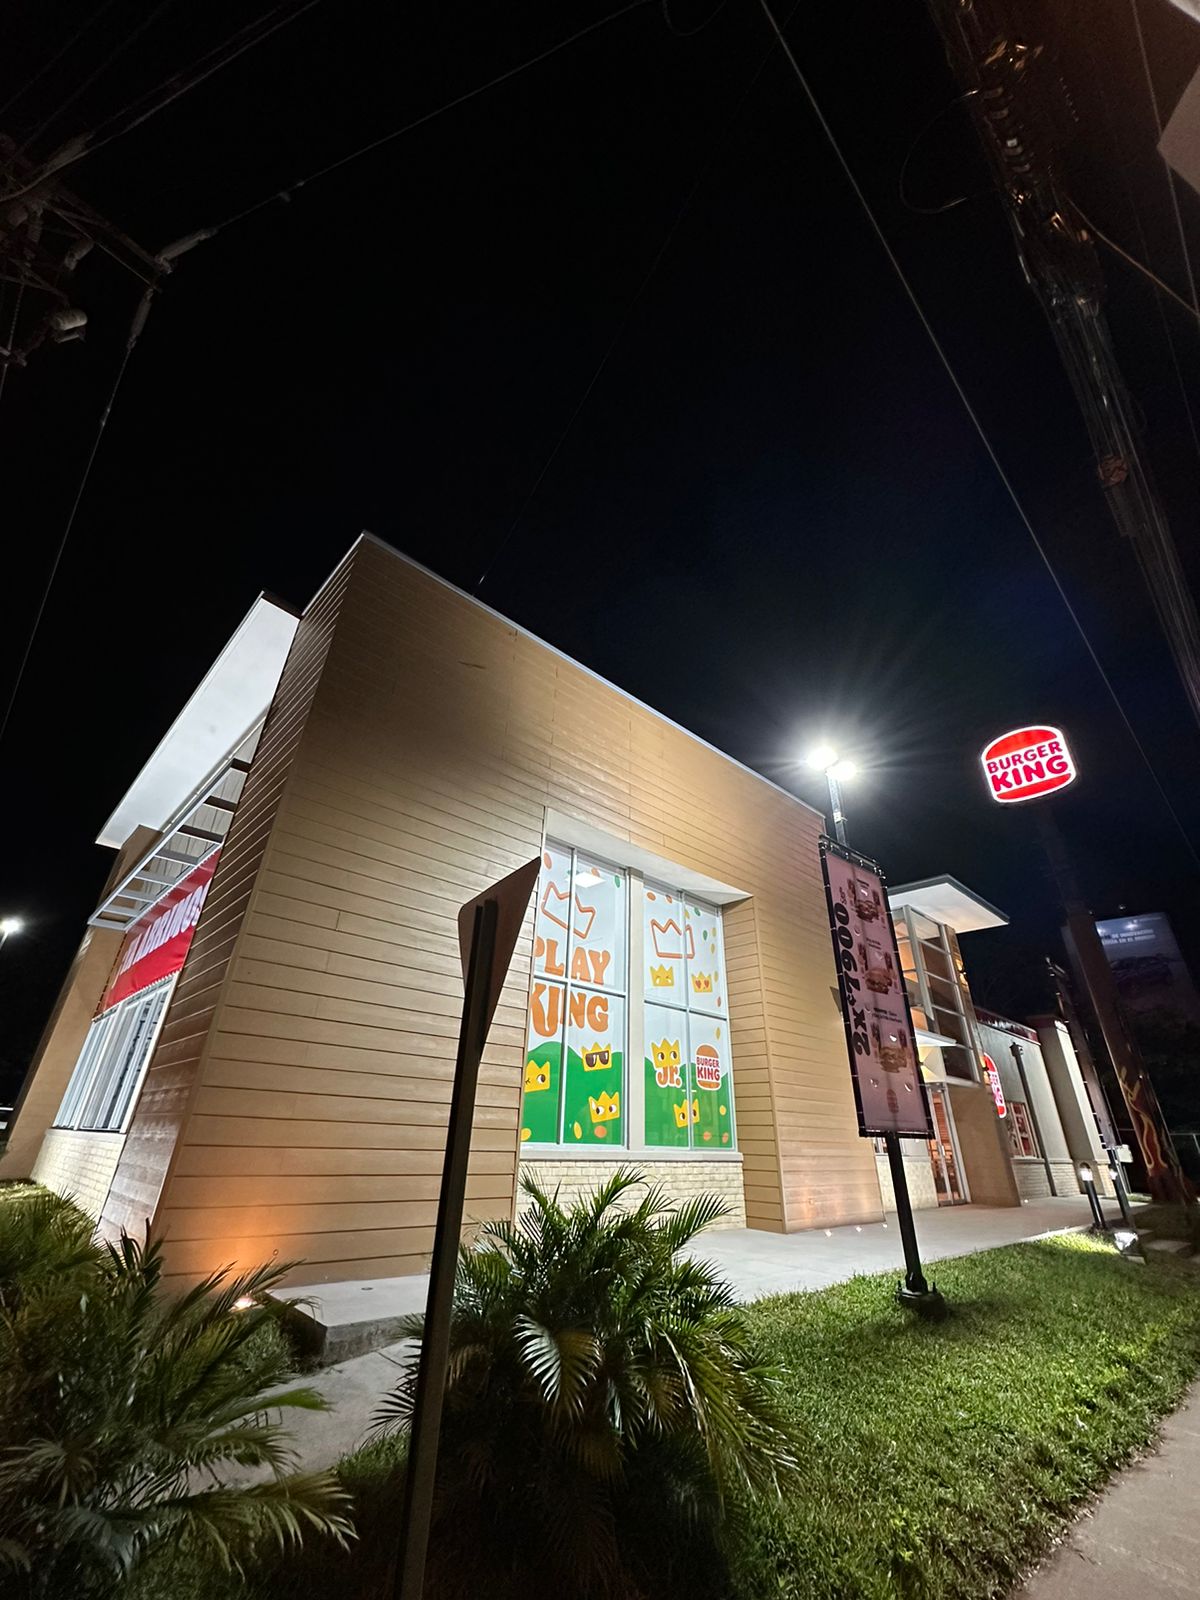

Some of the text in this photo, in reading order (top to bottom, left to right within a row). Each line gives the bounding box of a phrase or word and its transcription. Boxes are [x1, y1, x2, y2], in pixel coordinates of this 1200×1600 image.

[987, 741, 1062, 774] BURGER
[991, 755, 1068, 792] KING
[696, 1056, 720, 1068] BURGER
[657, 1065, 681, 1086] Jr.
[697, 1066, 720, 1081] KING
